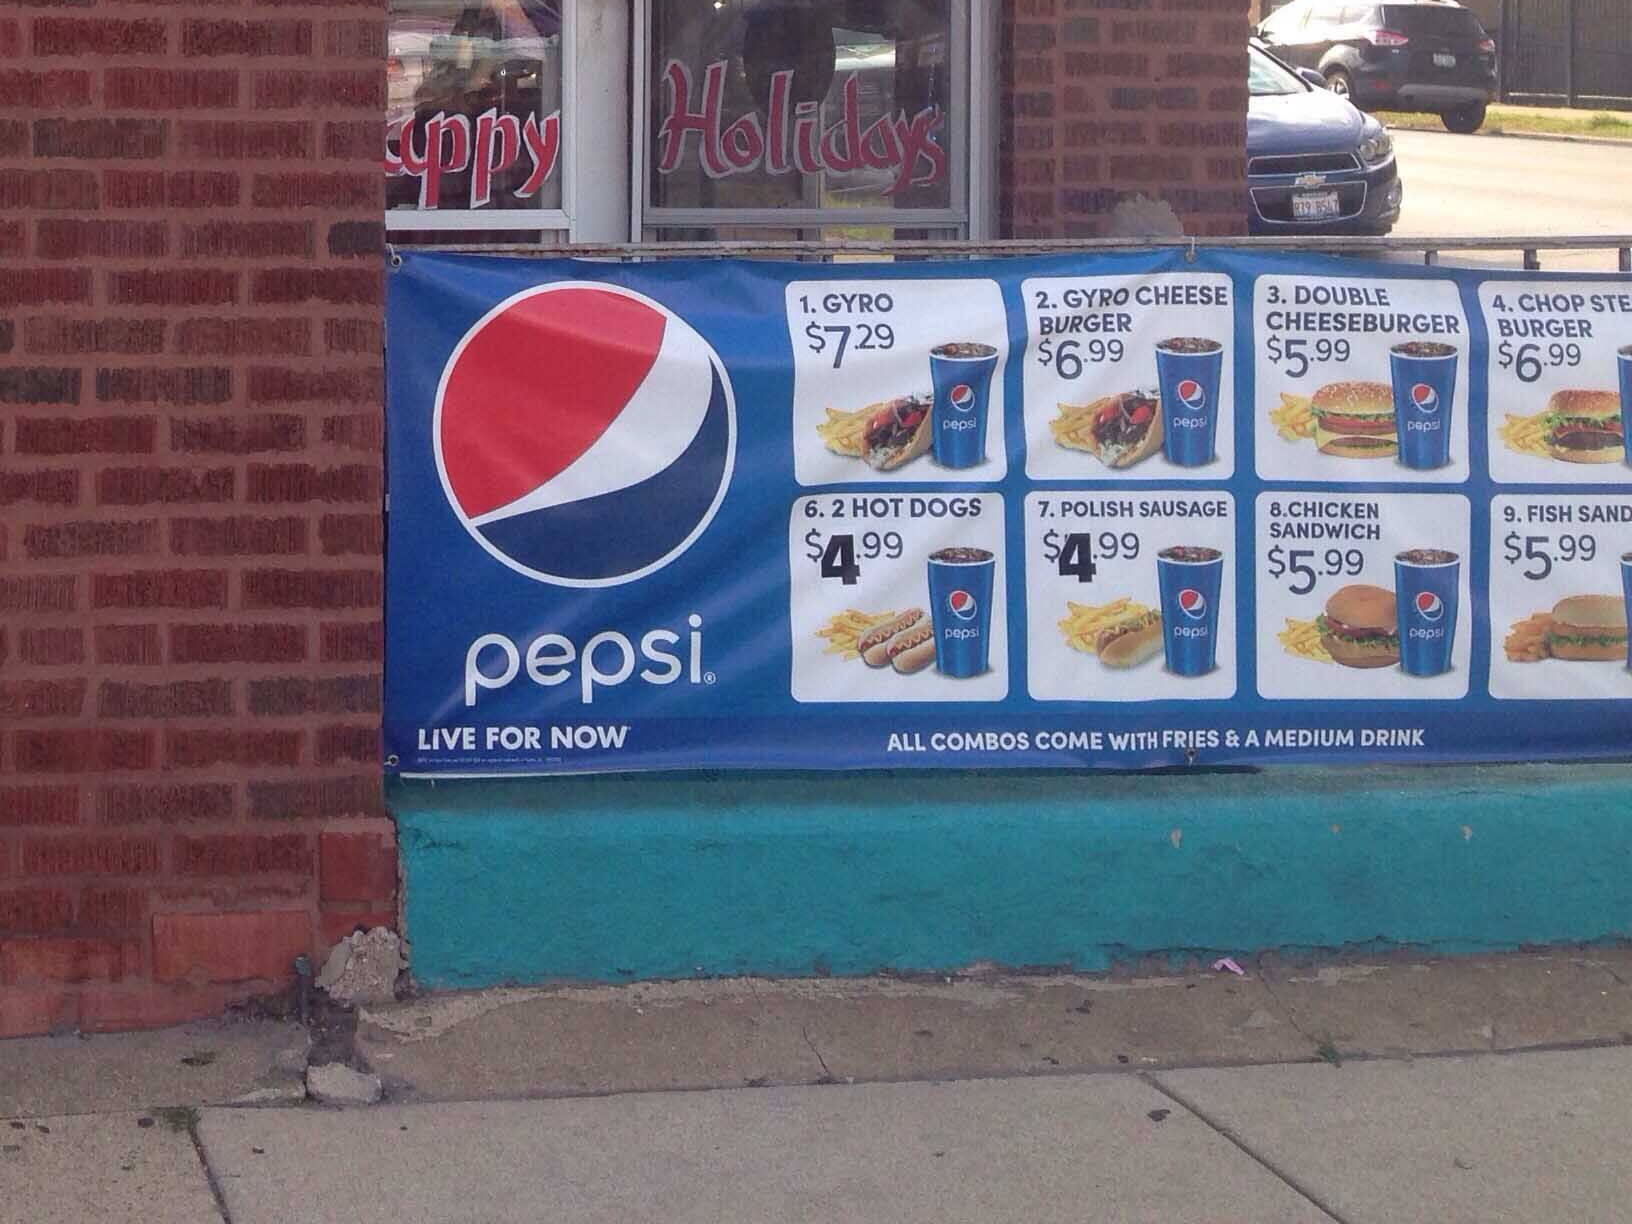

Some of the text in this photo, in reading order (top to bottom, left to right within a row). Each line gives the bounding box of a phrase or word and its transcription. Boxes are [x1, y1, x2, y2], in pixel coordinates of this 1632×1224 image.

[658, 59, 945, 198] Holidays
[823, 294, 893, 314] GYRO
[1063, 288, 1129, 309] GYRO
[1135, 286, 1228, 306] CHEESE
[1295, 286, 1390, 306] DOUBLE
[1519, 295, 1585, 313] CHOP
[1592, 295, 1632, 313] STE
[1040, 313, 1132, 335] BURGER
[1266, 312, 1459, 333] CHEESEBURGER
[1498, 319, 1592, 338] BURGER
[805, 321, 894, 368] $7.29
[1038, 338, 1123, 379] $6.99
[1267, 335, 1350, 378] $5.99
[1498, 341, 1580, 382] $6.99
[943, 417, 976, 431] pepsi
[1174, 416, 1207, 429] pepsi
[1407, 419, 1440, 432] pepsi
[832, 499, 846, 517] 2
[852, 498, 903, 517] HOT
[910, 498, 981, 517] DOGS
[1061, 501, 1133, 518] POLISH
[1140, 500, 1228, 518] SAUSAGE
[1528, 505, 1572, 522] FISH
[1270, 523, 1380, 540] SANDWICH
[1503, 531, 1596, 580] $5.99
[1267, 545, 1364, 594] $5.99
[944, 626, 979, 640] pepsi
[1174, 625, 1208, 639] pepsi
[1409, 627, 1444, 640] pepsi
[465, 613, 703, 706] pepsi
[418, 725, 628, 751] LIVE FOR NOW
[887, 728, 1425, 752] ALL COMBOS COME WITH FRIES & A MEDIUM DRINK
